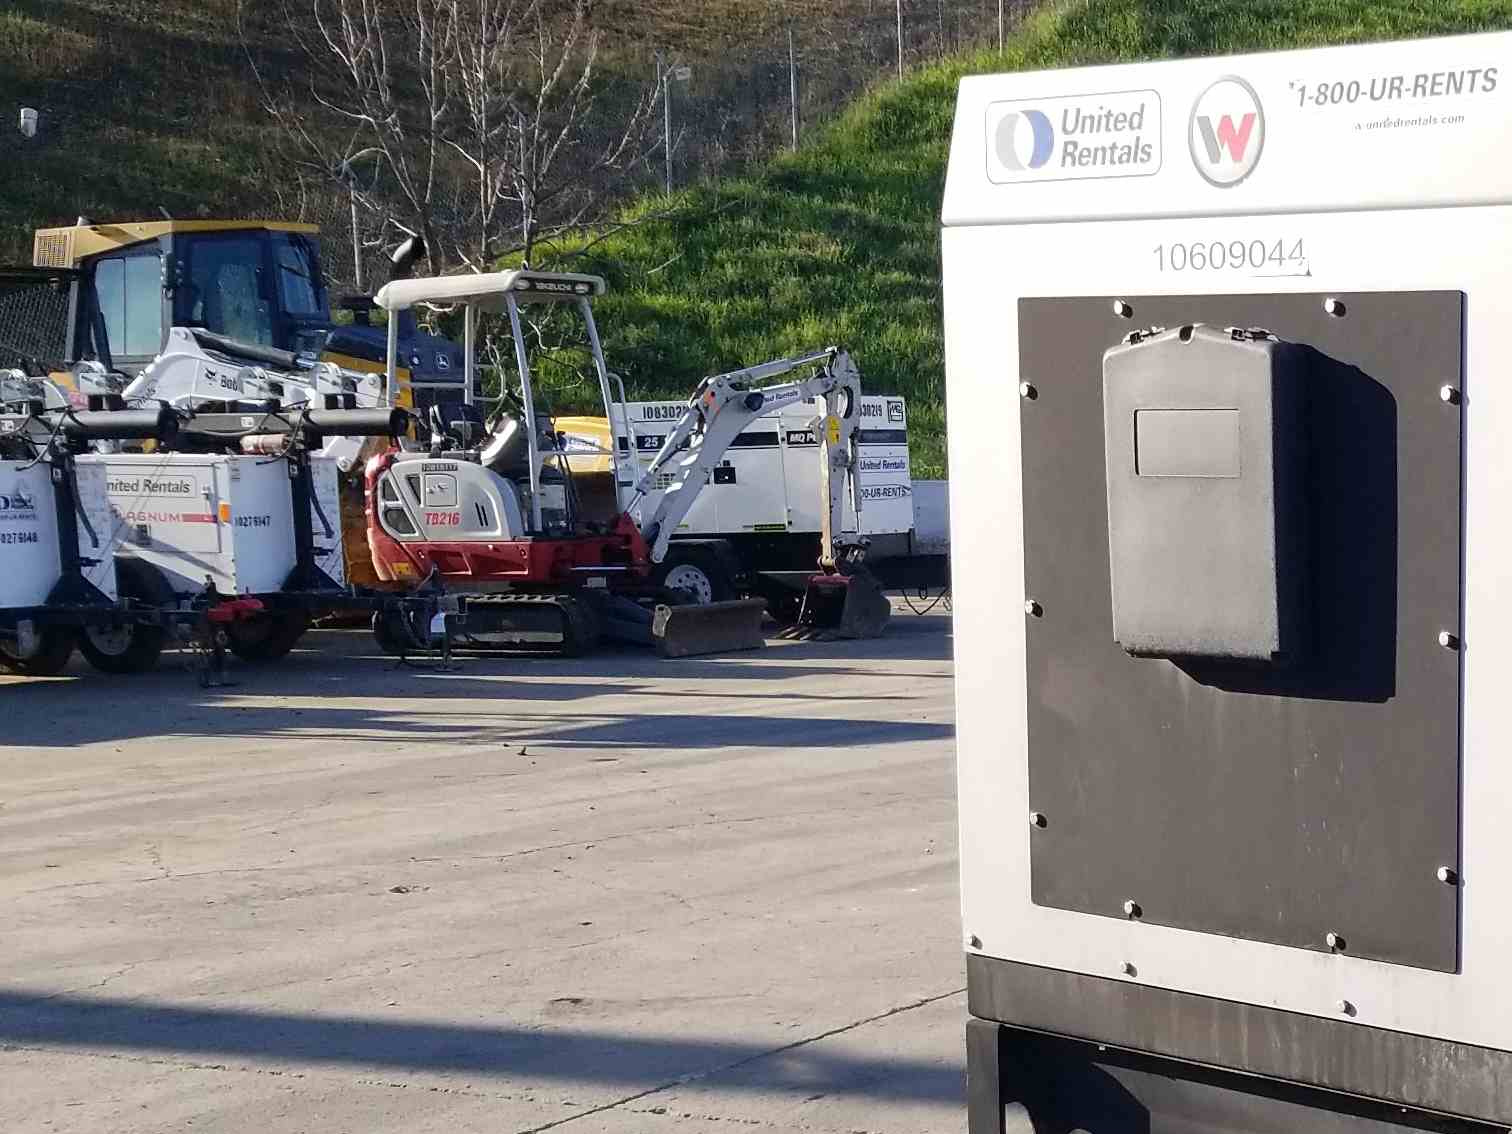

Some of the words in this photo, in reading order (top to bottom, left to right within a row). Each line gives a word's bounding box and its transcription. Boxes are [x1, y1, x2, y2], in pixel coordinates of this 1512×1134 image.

[1297, 67, 1499, 108] 1-800-UR-RENTS
[1061, 102, 1146, 135] United
[1060, 136, 1153, 168] Rentals
[1153, 238, 1306, 272] 10609044
[642, 405, 687, 420] 108302
[644, 437, 658, 448] 25
[882, 459, 906, 471] Rentals
[143, 479, 191, 494] Rentals
[425, 512, 461, 526] TB216
